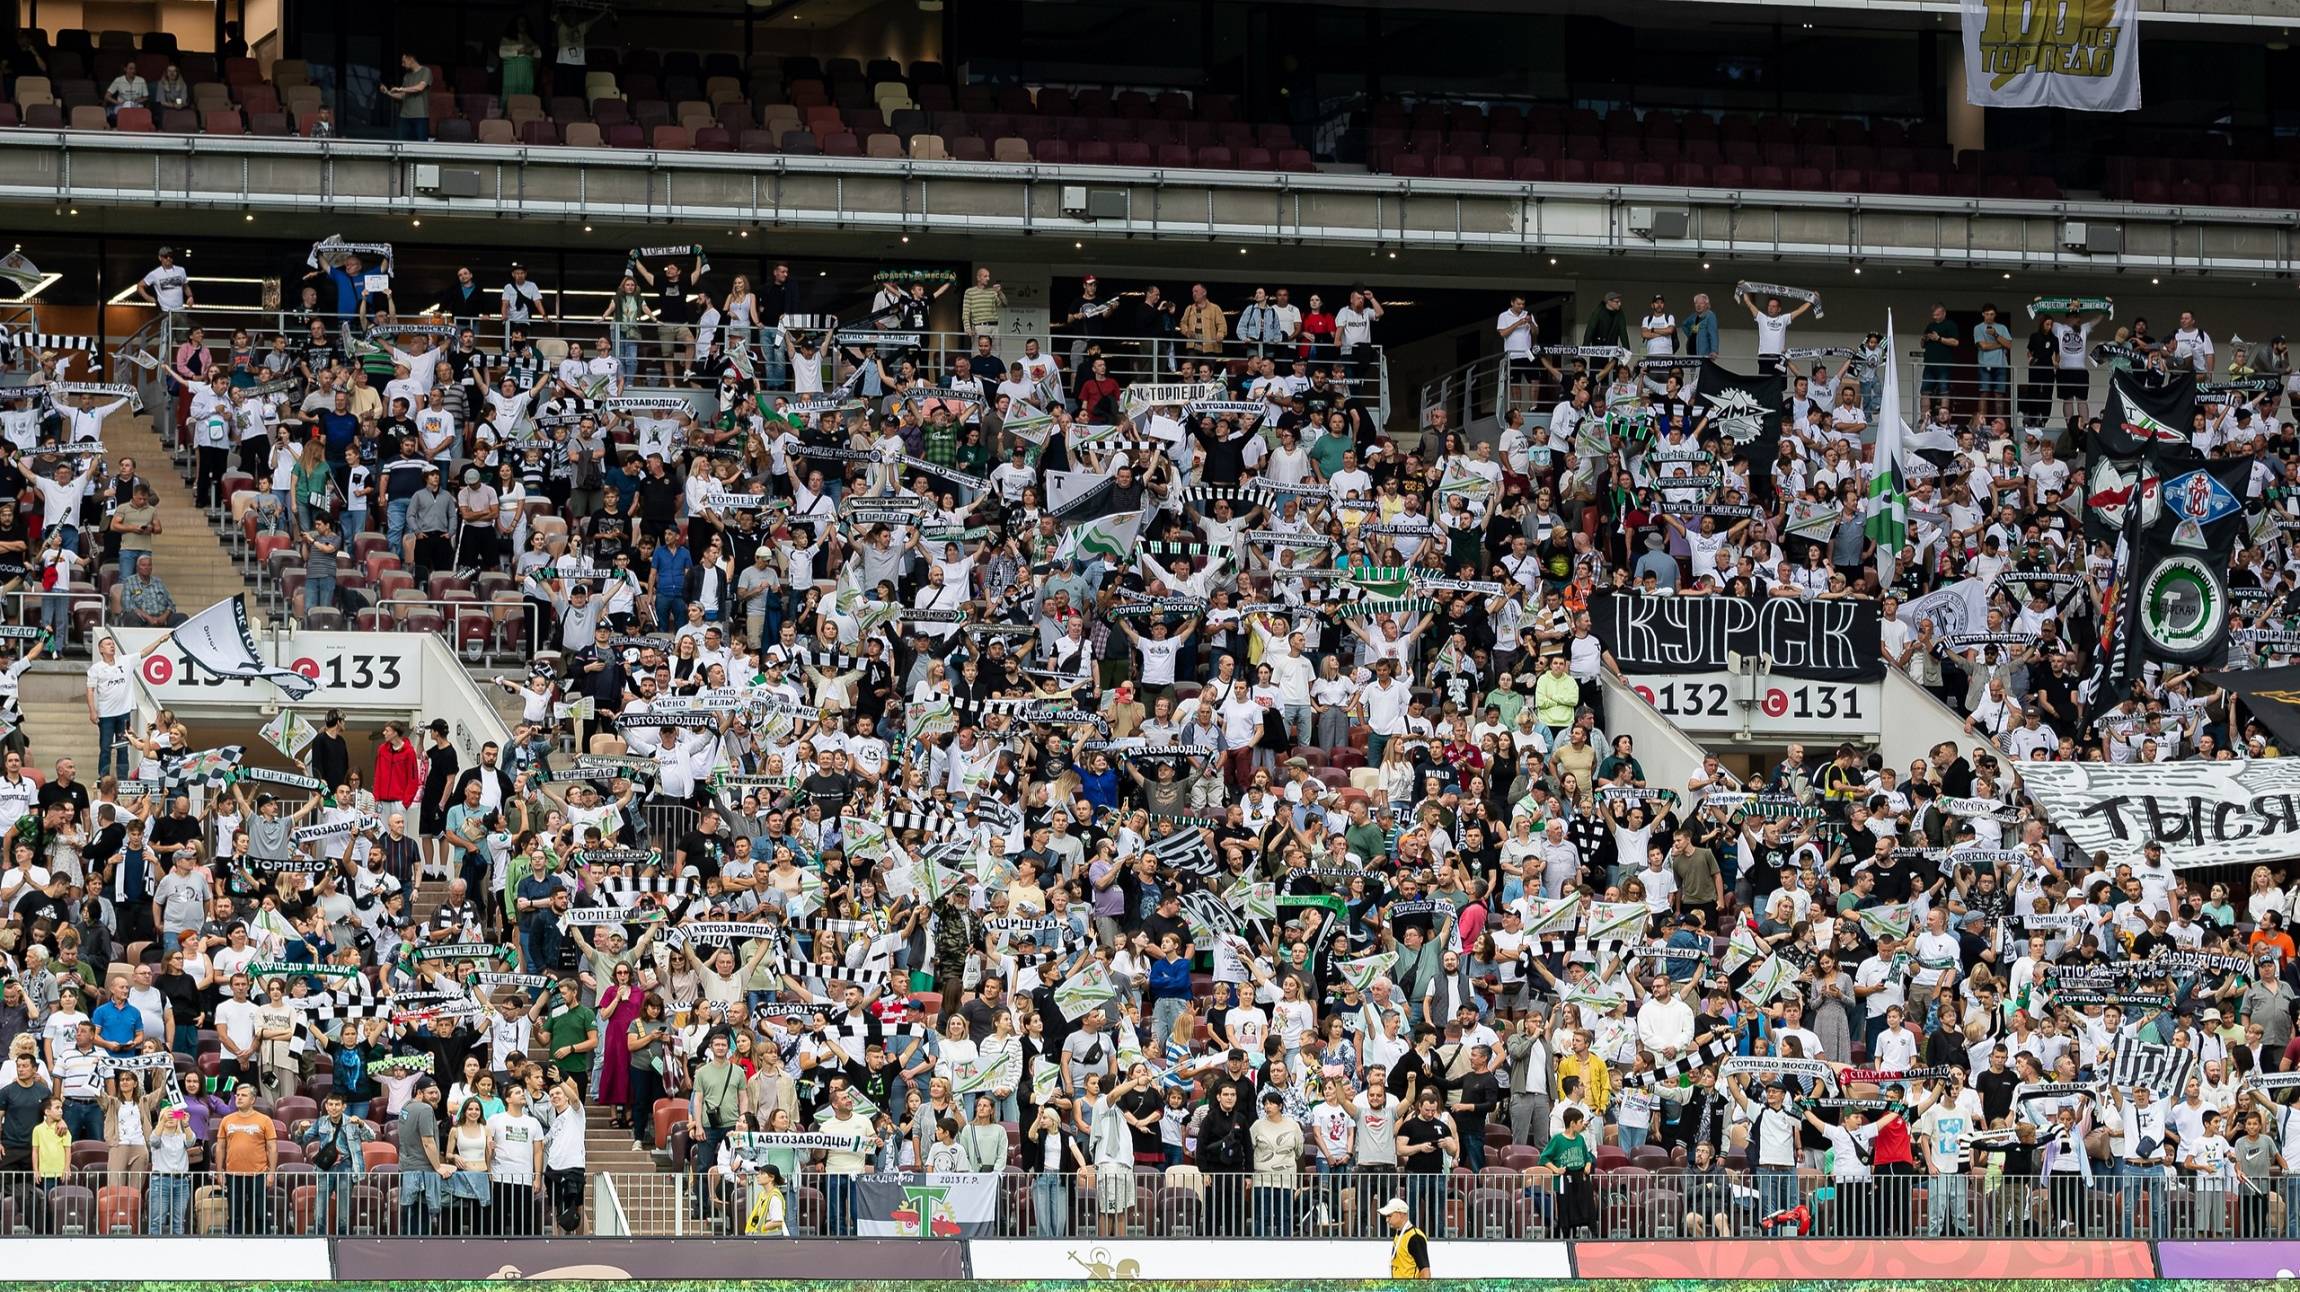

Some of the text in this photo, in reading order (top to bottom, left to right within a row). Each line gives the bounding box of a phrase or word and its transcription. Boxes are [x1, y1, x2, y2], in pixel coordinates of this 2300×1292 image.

[2079, 27, 2120, 48] ЛЕТ
[1980, 46, 2116, 76] ТОРПЕДО
[641, 246, 691, 257] ТОРПЕДО
[1541, 346, 1611, 356] TORPEDO MOSCOW
[1150, 386, 1205, 402] ТОРПЕДО
[609, 399, 684, 410] АВТОЗАВОДЦЫ
[2197, 396, 2225, 404] ТОРПЕДО
[1193, 402, 1262, 414] АВТОЗАВОДЦЫ
[800, 443, 869, 460] ТОРПЕДО МОСКВА
[1656, 451, 1704, 462] ТОРПЕДО
[713, 496, 761, 507] ТОРПЕДО
[888, 498, 914, 506] МОСКВА
[858, 512, 908, 523] ТОРПЕДО
[1396, 525, 1432, 535] МОСКВА
[1253, 531, 1314, 542] TORPEDO MOSCOW
[560, 568, 608, 578] ТОРПЕДО
[2005, 572, 2075, 583] АВТОЗАВОДЦЫ
[2234, 589, 2266, 598] МОСКВА
[1162, 603, 1197, 613] МОСКВА
[1615, 597, 1859, 670] КУРСК
[1953, 633, 2024, 645] АВТОЗАВОДЦЫ
[327, 656, 401, 690] 133
[707, 690, 735, 699] ЕРНО
[1659, 684, 1729, 716] 132
[654, 700, 685, 709] ЧЕРНО
[1794, 685, 1862, 718] 131
[628, 714, 710, 728] АВТОЗАВОДЦЫ
[1056, 712, 1101, 726] МОСКВА
[1127, 745, 1207, 757] АВТОЗАВОДЦЫ
[252, 769, 315, 789] ТОРПЕДО
[556, 769, 615, 780] ТОРПЕДО
[1425, 771, 1449, 779] WORLD
[1, 793, 34, 803] ТОРПЕДО
[1606, 789, 1653, 799] ТОРПЕДО
[2079, 795, 2300, 848] ТЫСЯ
[296, 817, 374, 842] АВТОЗАВОДЦЫ
[254, 861, 325, 873] ТОРПЕДО
[1394, 902, 1430, 913] ТОРПЕДО
[570, 910, 629, 921] ТОРПЕДО
[2030, 915, 2067, 925] ТОРПЕДО
[692, 924, 772, 939] АВТОЗАВОДЦЫ
[424, 944, 488, 957] ТОРПЕДО
[1638, 948, 1695, 958] ТОРПЕДО
[254, 962, 351, 975] ТОРПЕДО МОСКВА
[481, 973, 541, 985] ТОРПЕДО
[2060, 979, 2113, 989] ТОРПЕДО
[2058, 996, 2162, 1004] ТОРПЕДО МОСКВА
[1730, 1060, 1778, 1071] ТОРПЕДО
[1781, 1061, 1824, 1074] МОСКВА
[1850, 1066, 1949, 1080] СПАРТАК ТОРПЕДО
[2039, 1083, 2087, 1092] TORPEDO
[757, 1134, 852, 1149] АВТОЗАВОДЦЫ
[863, 1174, 914, 1184] АКАДЕМИЯ
[940, 1175, 960, 1185] 2013
